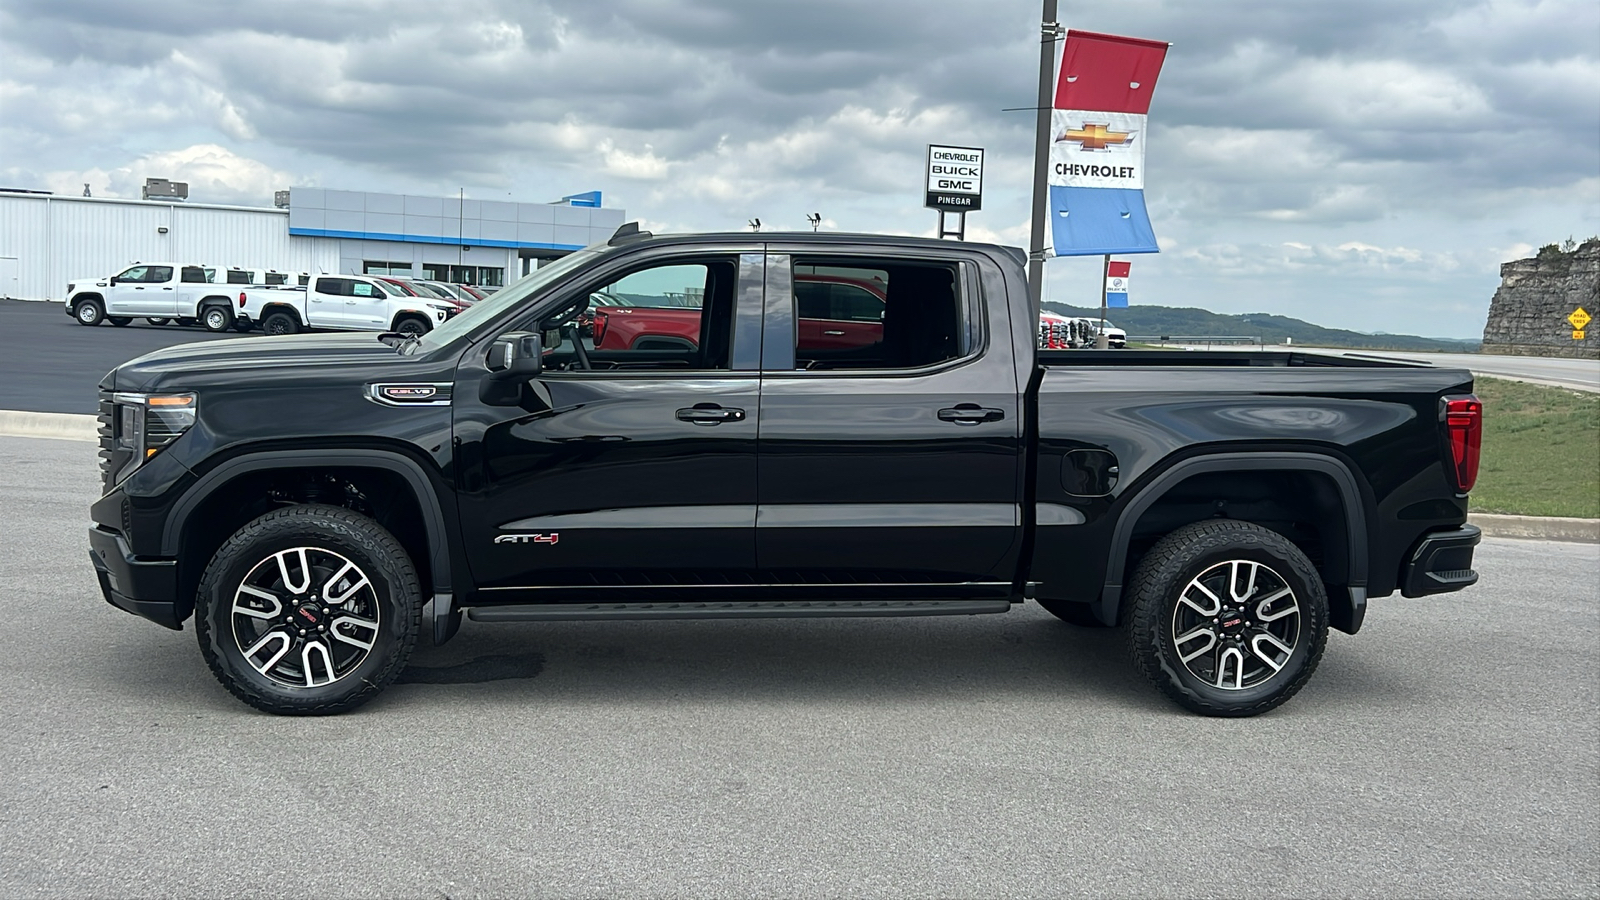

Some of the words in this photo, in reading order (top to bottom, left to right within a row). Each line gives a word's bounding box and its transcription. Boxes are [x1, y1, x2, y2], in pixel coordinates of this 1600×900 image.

[934, 152, 979, 162] CHEVROLET
[932, 165, 979, 176] BUICK
[938, 179, 972, 190] GMC
[937, 196, 971, 206] PINEGAR
[494, 533, 559, 545] AT4
